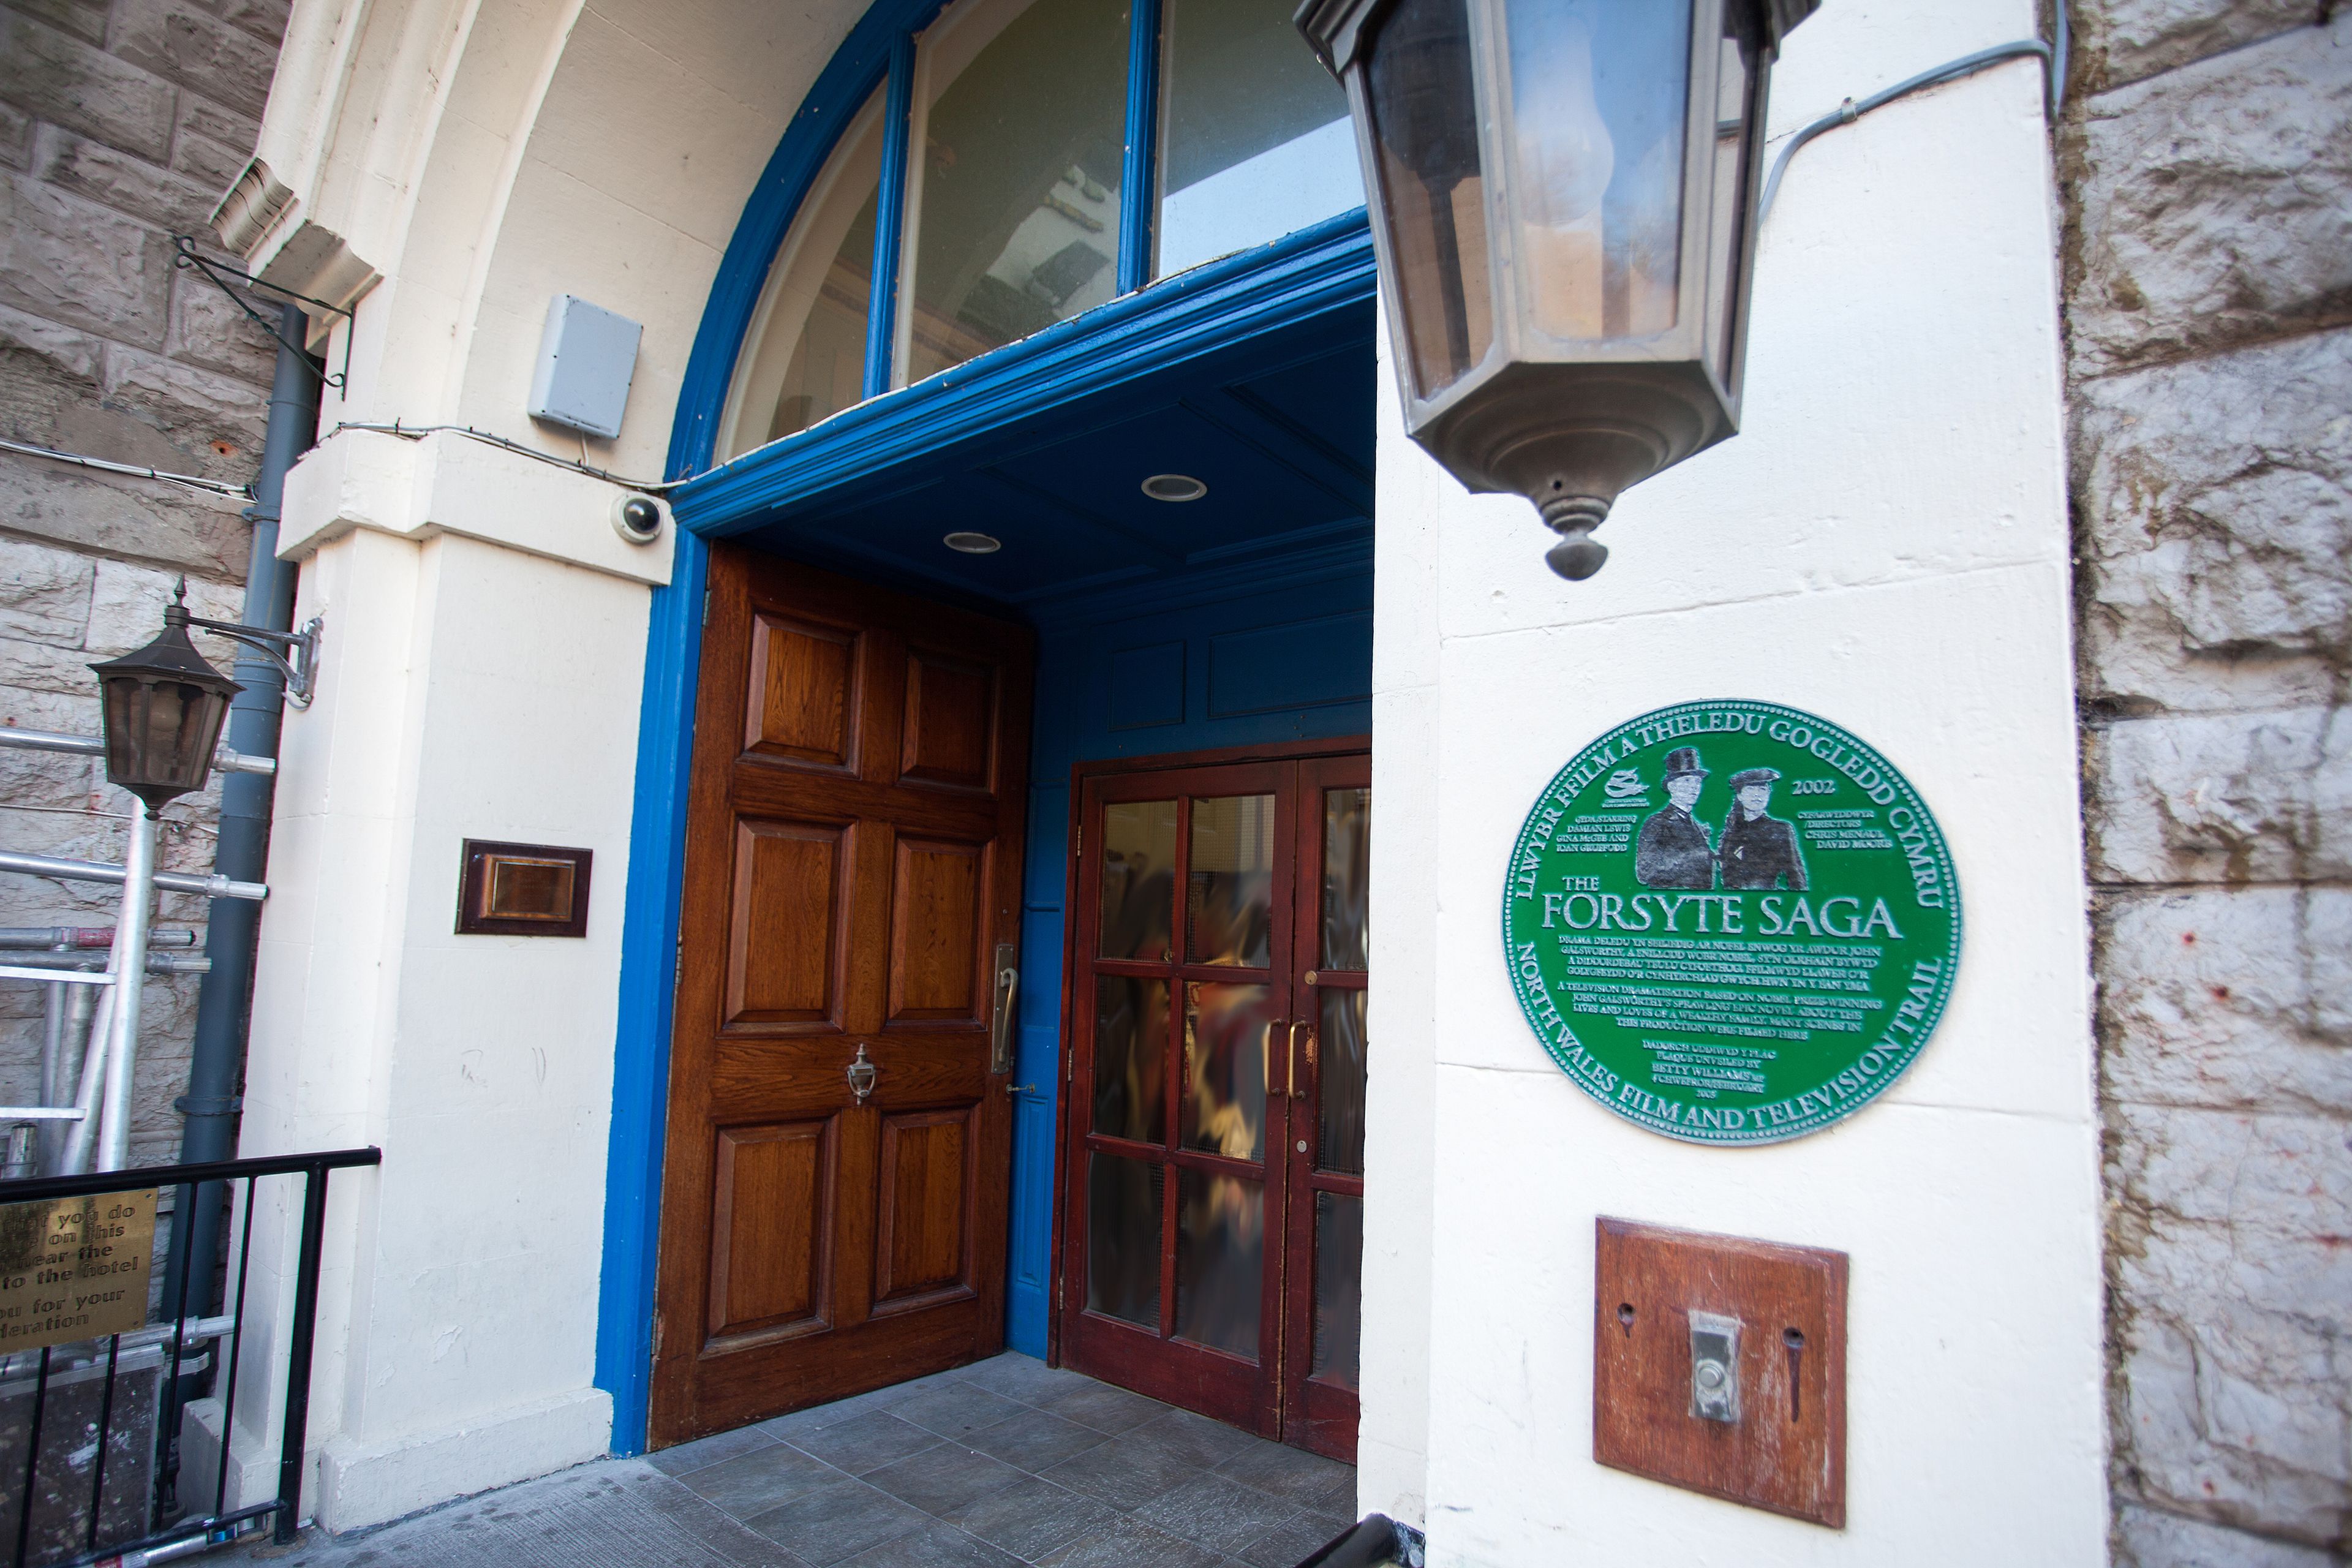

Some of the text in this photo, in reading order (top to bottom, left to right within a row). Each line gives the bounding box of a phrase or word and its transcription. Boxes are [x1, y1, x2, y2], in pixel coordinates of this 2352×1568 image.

[1792, 780, 1836, 795] 2002
[1516, 712, 1943, 908] LLWYBR FFILM A THELEDU GOGLEDD CYMRU
[1805, 831, 1837, 839] CHRIS
[1817, 840, 1850, 849] DAVID
[1562, 877, 1599, 891] THE
[1541, 894, 1904, 938] FORSYTE SAGA
[1561, 946, 1625, 957] GALSWORTHY,
[1594, 937, 1630, 946] DELEDU
[1849, 947, 1882, 957] JOHN
[1568, 956, 1575, 965] A
[1558, 981, 1564, 990] A
[1566, 982, 1619, 993] TELEVISION
[1621, 986, 1702, 997] DRAMATISATION
[1704, 990, 1736, 1000] BASED
[1738, 993, 1755, 1001] ON
[1757, 994, 1792, 1004] NOBEL
[1573, 993, 1597, 1002] JOHN
[1672, 1000, 1730, 1011] SPRAWLING
[1733, 1004, 1757, 1013] EPIC
[1758, 1005, 1793, 1016] NOVEL
[1798, 1008, 1836, 1018] ABOUT
[1838, 1011, 1862, 1020] THE
[1573, 1003, 1598, 1013] LIVES
[1600, 1006, 1621, 1014] AND
[1623, 1007, 1653, 1016] LOVES
[1679, 1011, 1725, 1022] WEALTHY
[1803, 1020, 1844, 1031] SCENES
[1846, 1022, 1861, 1032] IN
[1517, 941, 1942, 1129] NORTH WALES FILM AND TELEVISION TRAIL
[1616, 1018, 1808, 1040] THIS PRODUCTION WERE FILMED HERE
[1657, 1051, 1694, 1063] PLAQUE
[1695, 1055, 1745, 1067] UNVEILED
[1651, 1063, 1689, 1075] BETTY
[1692, 1068, 1751, 1081] WILLIAMS
[59, 1211, 99, 1229] you
[108, 1204, 136, 1219] do
[48, 1231, 77, 1245] on
[88, 1223, 125, 1240] this
[18, 1251, 69, 1268] near
[78, 1244, 113, 1260] the
[2, 1256, 139, 1290] to the hotel
[33, 1298, 66, 1314] for
[76, 1289, 126, 1311] your
